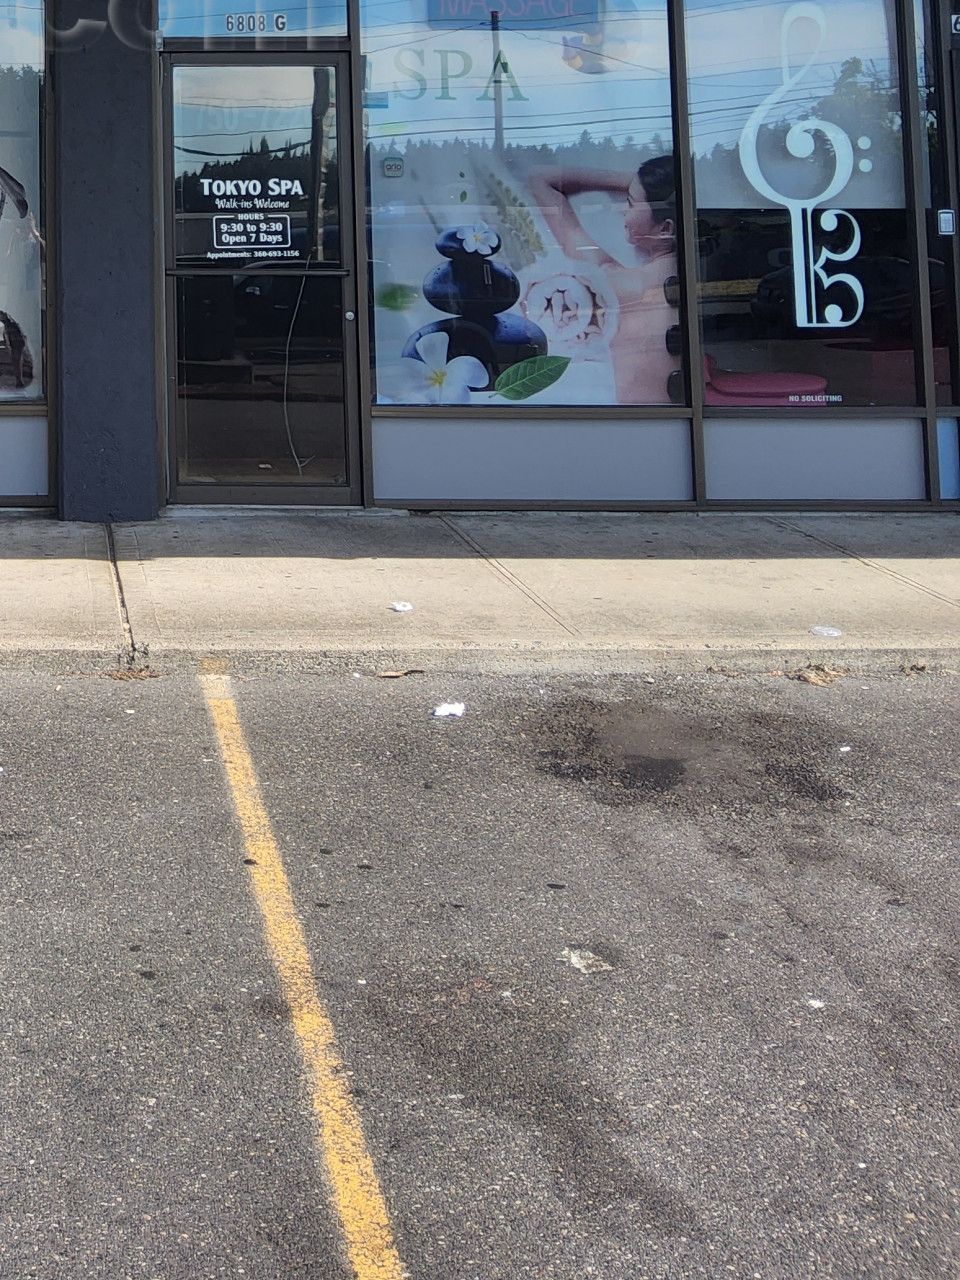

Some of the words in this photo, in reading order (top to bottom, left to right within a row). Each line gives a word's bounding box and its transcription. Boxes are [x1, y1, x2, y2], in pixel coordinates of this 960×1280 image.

[226, 15, 266, 32] 6808
[275, 15, 286, 31] G
[392, 48, 530, 101] SPA
[215, 197, 253, 209] Walk-ins
[253, 197, 290, 209] Welcome
[220, 223, 244, 232] 9:30
[246, 223, 257, 231] to
[259, 222, 283, 231] 9:30
[221, 233, 247, 244] Open
[249, 233, 256, 242] 7
[259, 232, 283, 244] Days
